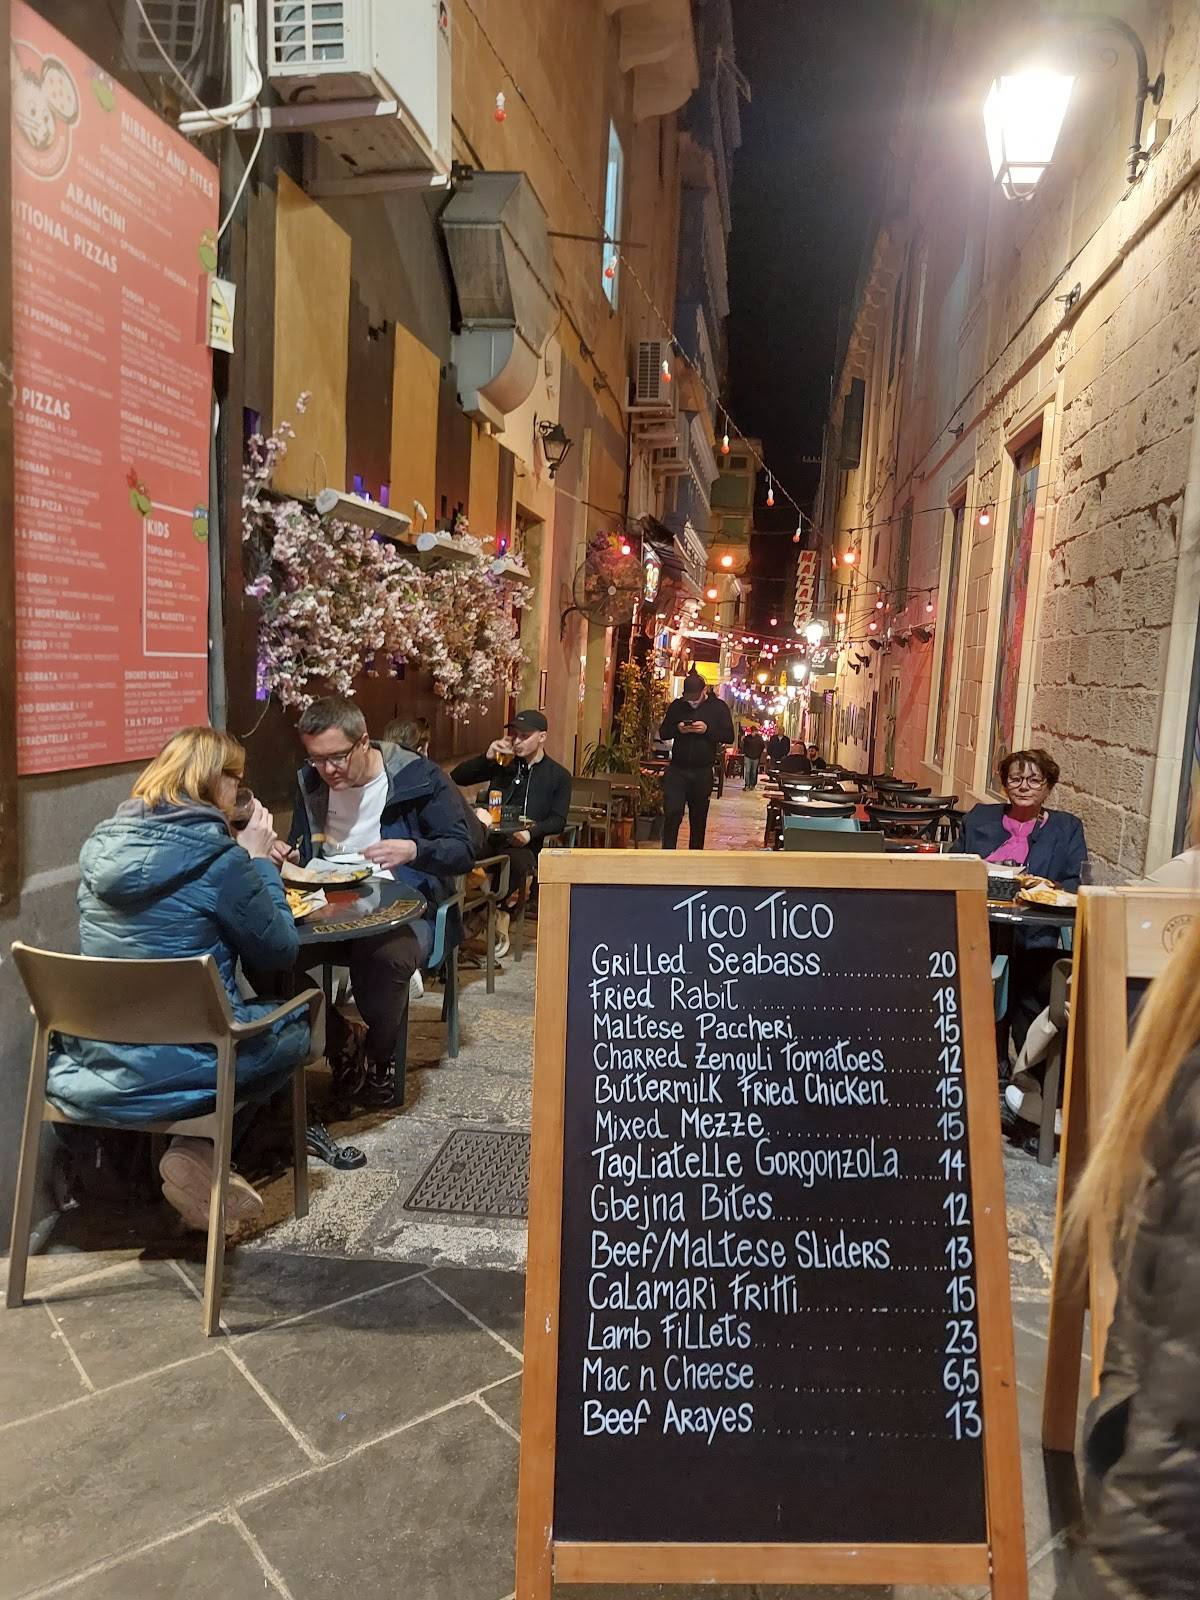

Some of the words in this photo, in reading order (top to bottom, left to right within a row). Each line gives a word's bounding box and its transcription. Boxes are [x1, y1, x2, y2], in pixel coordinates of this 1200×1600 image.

[121, 111, 164, 161] NIBBLES
[167, 148, 189, 177] AND
[66, 182, 126, 234] ARANCINI
[74, 232, 118, 274] PIZZAS
[22, 386, 71, 421] PIZZAS
[147, 520, 170, 539] KIDS
[591, 942, 687, 977] Grilled
[708, 942, 821, 977] Seabass
[928, 950, 958, 979] 20
[588, 976, 656, 1010] Fried
[671, 977, 740, 1011] Rabit
[932, 986, 957, 1014] 18
[593, 1012, 685, 1041] Maltese
[695, 1012, 793, 1041] Paccheri
[933, 1013, 961, 1044] 15
[593, 1041, 688, 1072] Charred
[780, 1039, 885, 1073] Tomatoes
[937, 1044, 963, 1075] 12
[595, 1071, 723, 1106] Buttermilk
[737, 1071, 799, 1107] Fried
[804, 1072, 889, 1107] Chicken
[935, 1076, 964, 1110] 15
[595, 1109, 670, 1144] Mixed
[681, 1107, 766, 1140] Mezze
[936, 1111, 965, 1142] 15
[592, 1142, 744, 1188] Tagliatelle
[755, 1136, 900, 1188] Gorgonzola
[937, 1148, 966, 1183] 14
[591, 1184, 686, 1231] Gbejna
[701, 1183, 774, 1223] Bites
[942, 1191, 971, 1227] 12
[591, 1228, 787, 1274] Beef/Maltese
[794, 1229, 891, 1270] Sliders
[944, 1235, 973, 1271] 13
[588, 1271, 717, 1311] Calamari
[728, 1270, 799, 1315] Fritti
[945, 1274, 976, 1314] 15
[587, 1311, 652, 1351] Lamb
[659, 1311, 752, 1351] Fillets
[945, 1319, 979, 1355] 23
[582, 1356, 631, 1393] Mac
[639, 1364, 657, 1393] n
[663, 1354, 755, 1392] Cheese
[582, 1398, 652, 1437] Beef
[662, 1398, 755, 1446] Arayes
[944, 1399, 983, 1442] 13
